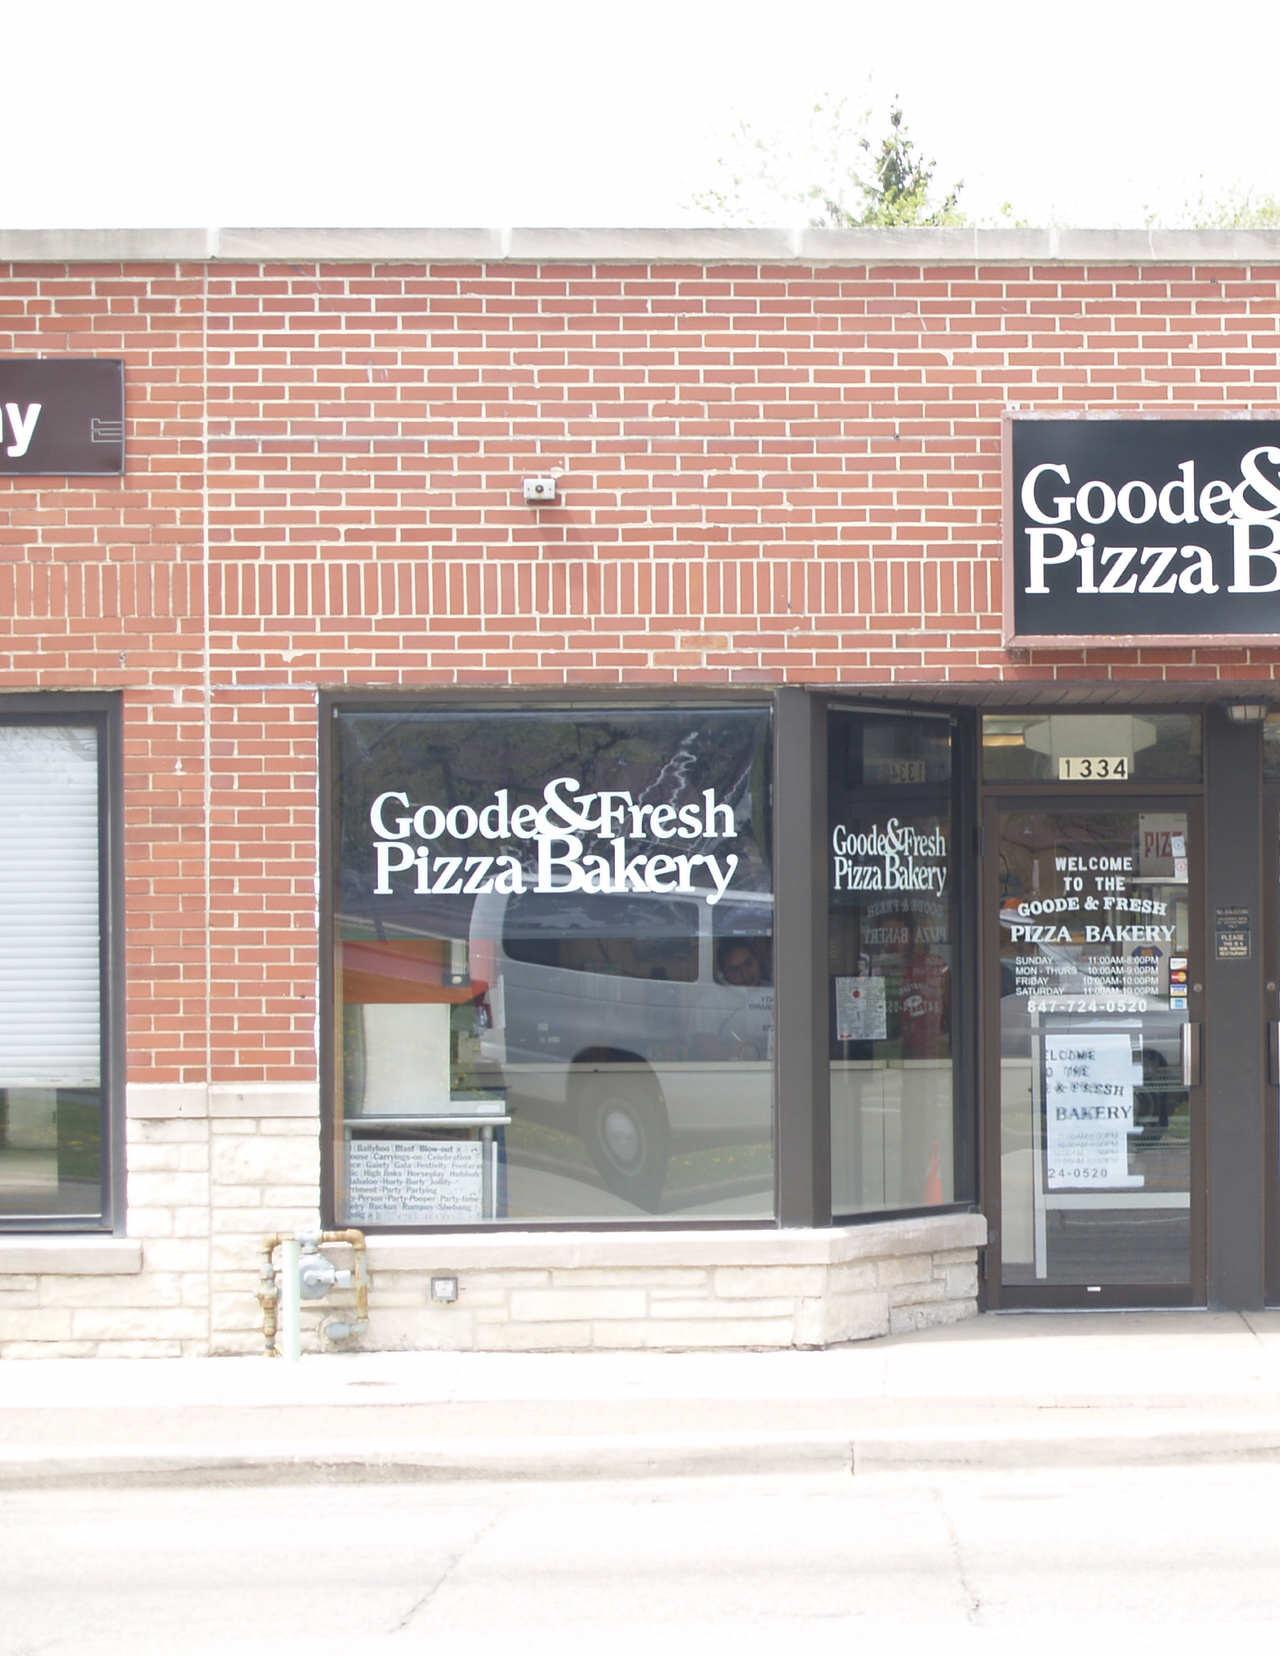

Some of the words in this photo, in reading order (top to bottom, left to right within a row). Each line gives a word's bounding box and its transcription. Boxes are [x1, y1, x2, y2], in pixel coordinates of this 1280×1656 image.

[1025, 527, 1219, 595] Pizza
[1065, 758, 1126, 778] 1334
[1144, 831, 1183, 857] PIZ
[373, 842, 527, 895] Pizza
[534, 834, 739, 904] Bakery
[1055, 857, 1133, 871] WELCOME
[834, 856, 883, 890] Pizza
[884, 850, 947, 897] Bakery
[1063, 877, 1083, 891] TO
[1095, 877, 1126, 891] THE
[1018, 897, 1080, 917] GOODE
[1084, 896, 1098, 910] &
[1103, 897, 1168, 916] FRESH
[1011, 925, 1072, 942] PIZZA
[1085, 925, 1176, 942] BAKERY
[1015, 956, 1053, 965] SUNDAY
[1015, 966, 1038, 975] MON
[1015, 977, 1049, 985] FRIDAY
[1015, 987, 1065, 996] SATURDAY
[1027, 1000, 1147, 1013] 847-724-0520
